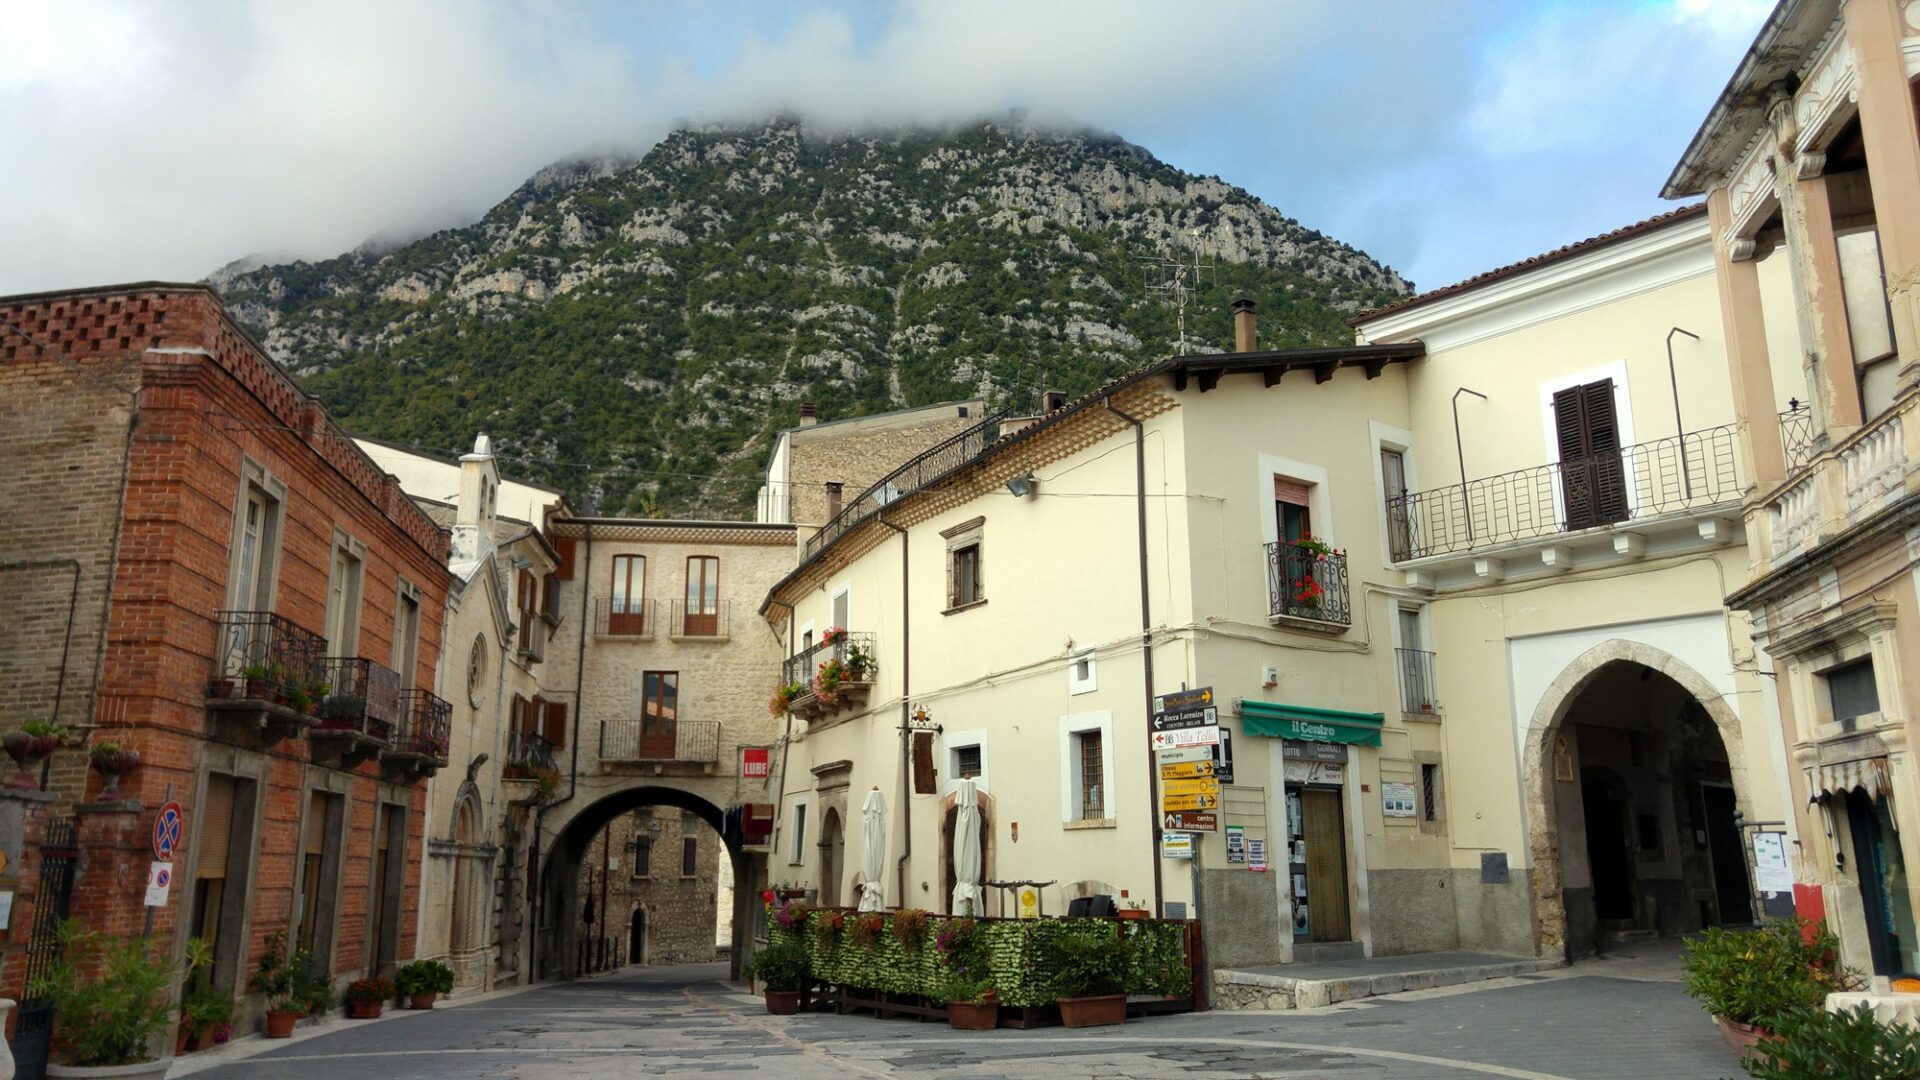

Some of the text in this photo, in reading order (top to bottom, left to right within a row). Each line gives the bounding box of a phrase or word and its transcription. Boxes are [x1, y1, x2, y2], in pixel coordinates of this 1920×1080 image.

[1164, 714, 1179, 722] Rocca
[1292, 721, 1300, 733] il
[1300, 722, 1335, 736] Centro
[1283, 747, 1300, 757] LOTTO
[1317, 743, 1341, 753] GIORNALI
[744, 762, 768, 775] LUBE
